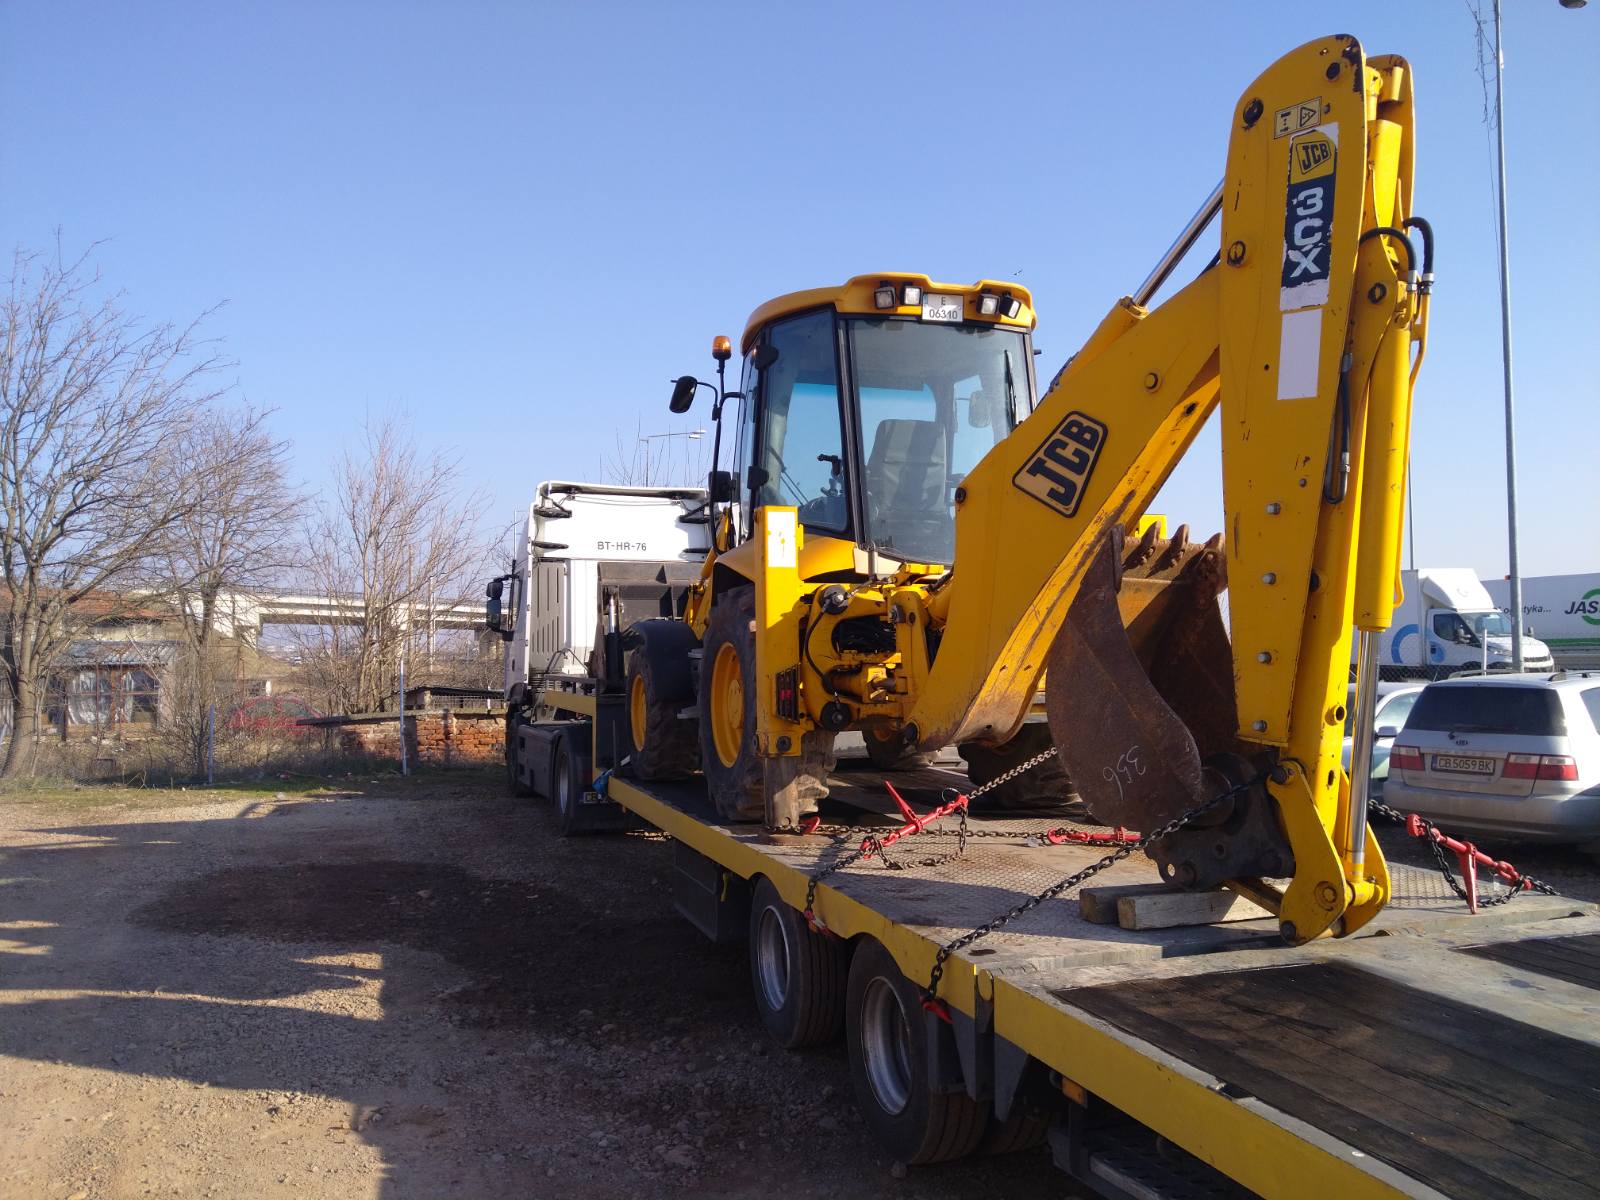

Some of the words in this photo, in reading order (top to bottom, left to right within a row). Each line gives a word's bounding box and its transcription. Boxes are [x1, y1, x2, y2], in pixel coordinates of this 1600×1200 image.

[1299, 143, 1328, 171] JCB
[1289, 186, 1325, 278] 3CX
[941, 296, 946, 306] E
[929, 308, 958, 320] 06310
[1026, 419, 1100, 507] JCB
[597, 541, 647, 551] BT-HR-76
